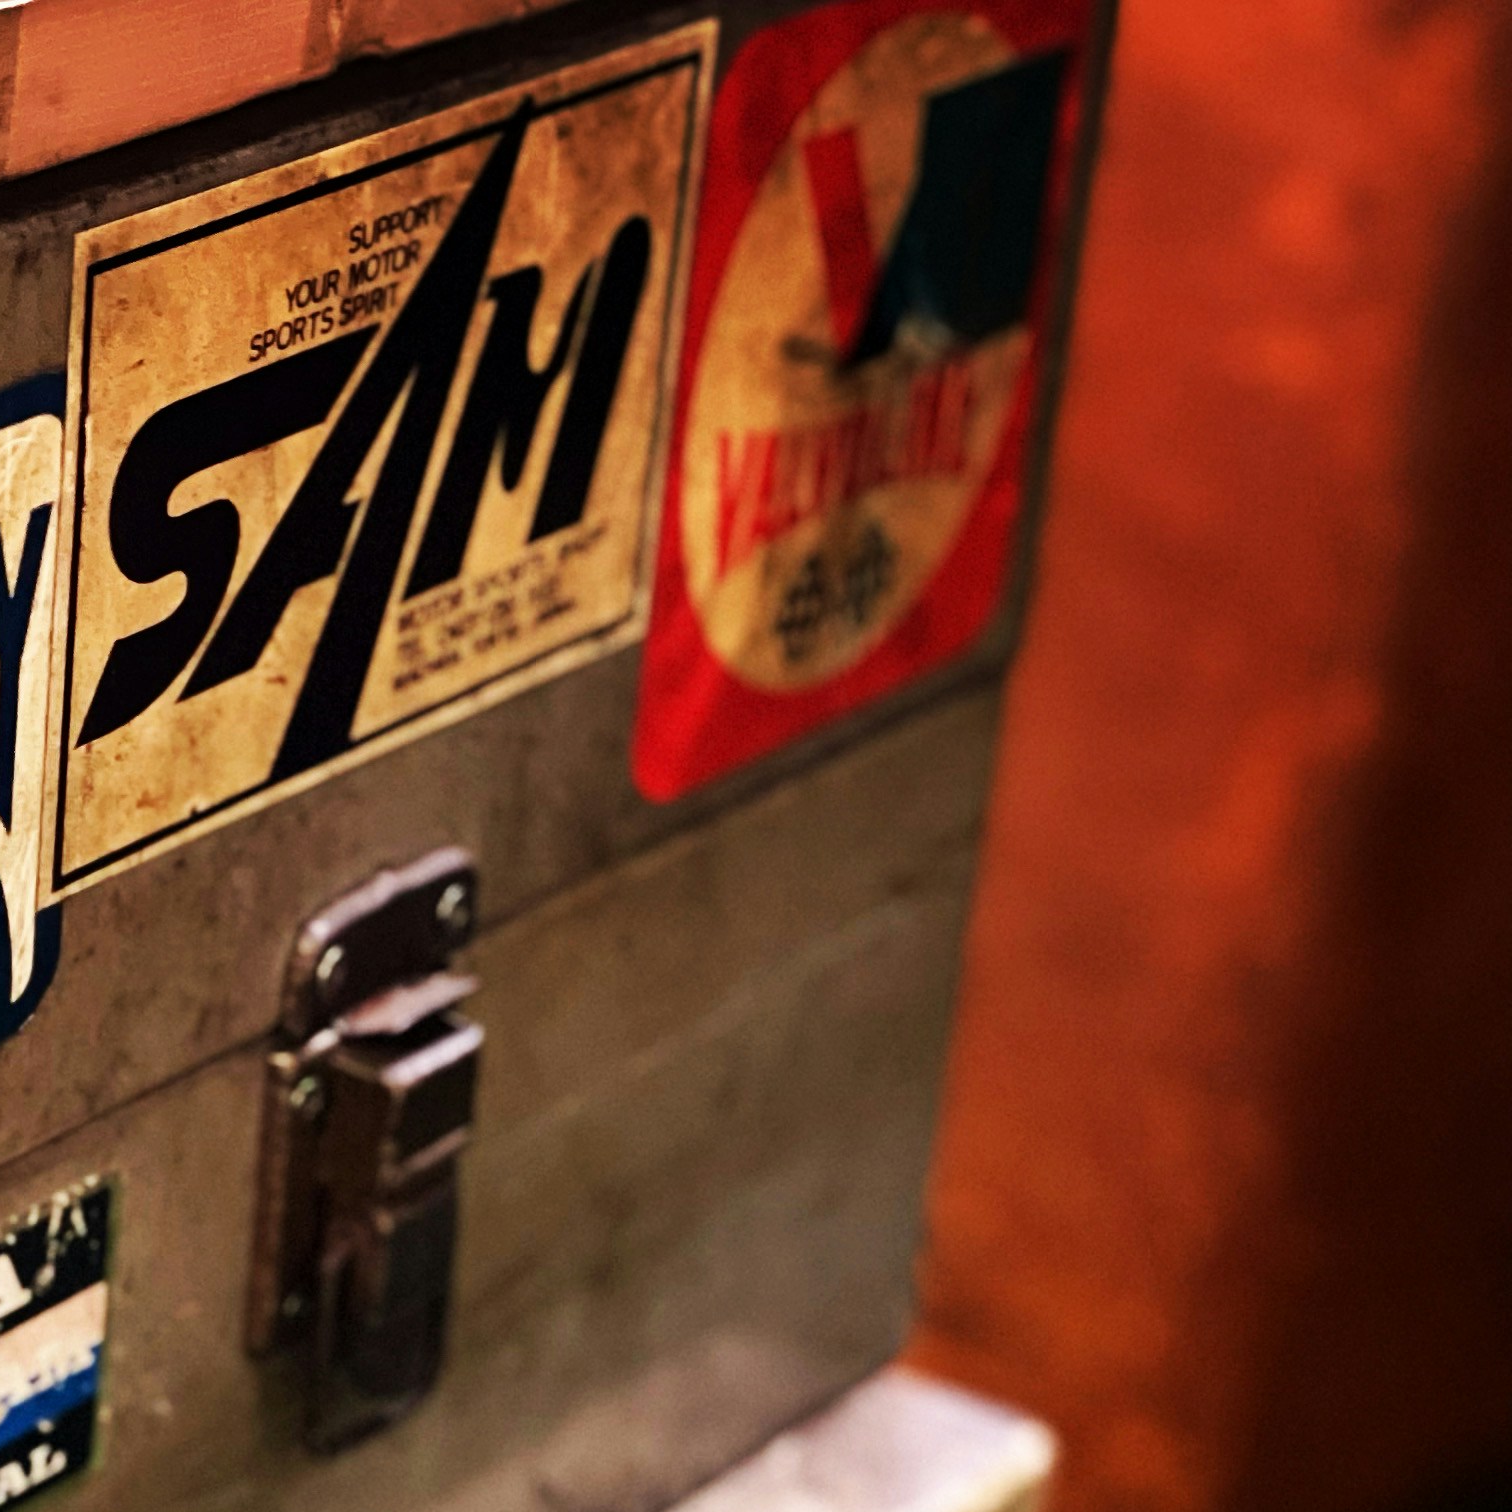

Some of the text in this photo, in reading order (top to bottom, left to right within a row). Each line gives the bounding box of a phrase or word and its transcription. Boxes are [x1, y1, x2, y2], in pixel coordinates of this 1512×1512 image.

[348, 195, 446, 254] SUPPORT
[285, 239, 422, 313] YOUR MOTOR
[248, 281, 401, 363] SPORTS SPIRIT
[74, 96, 651, 786] SAM
